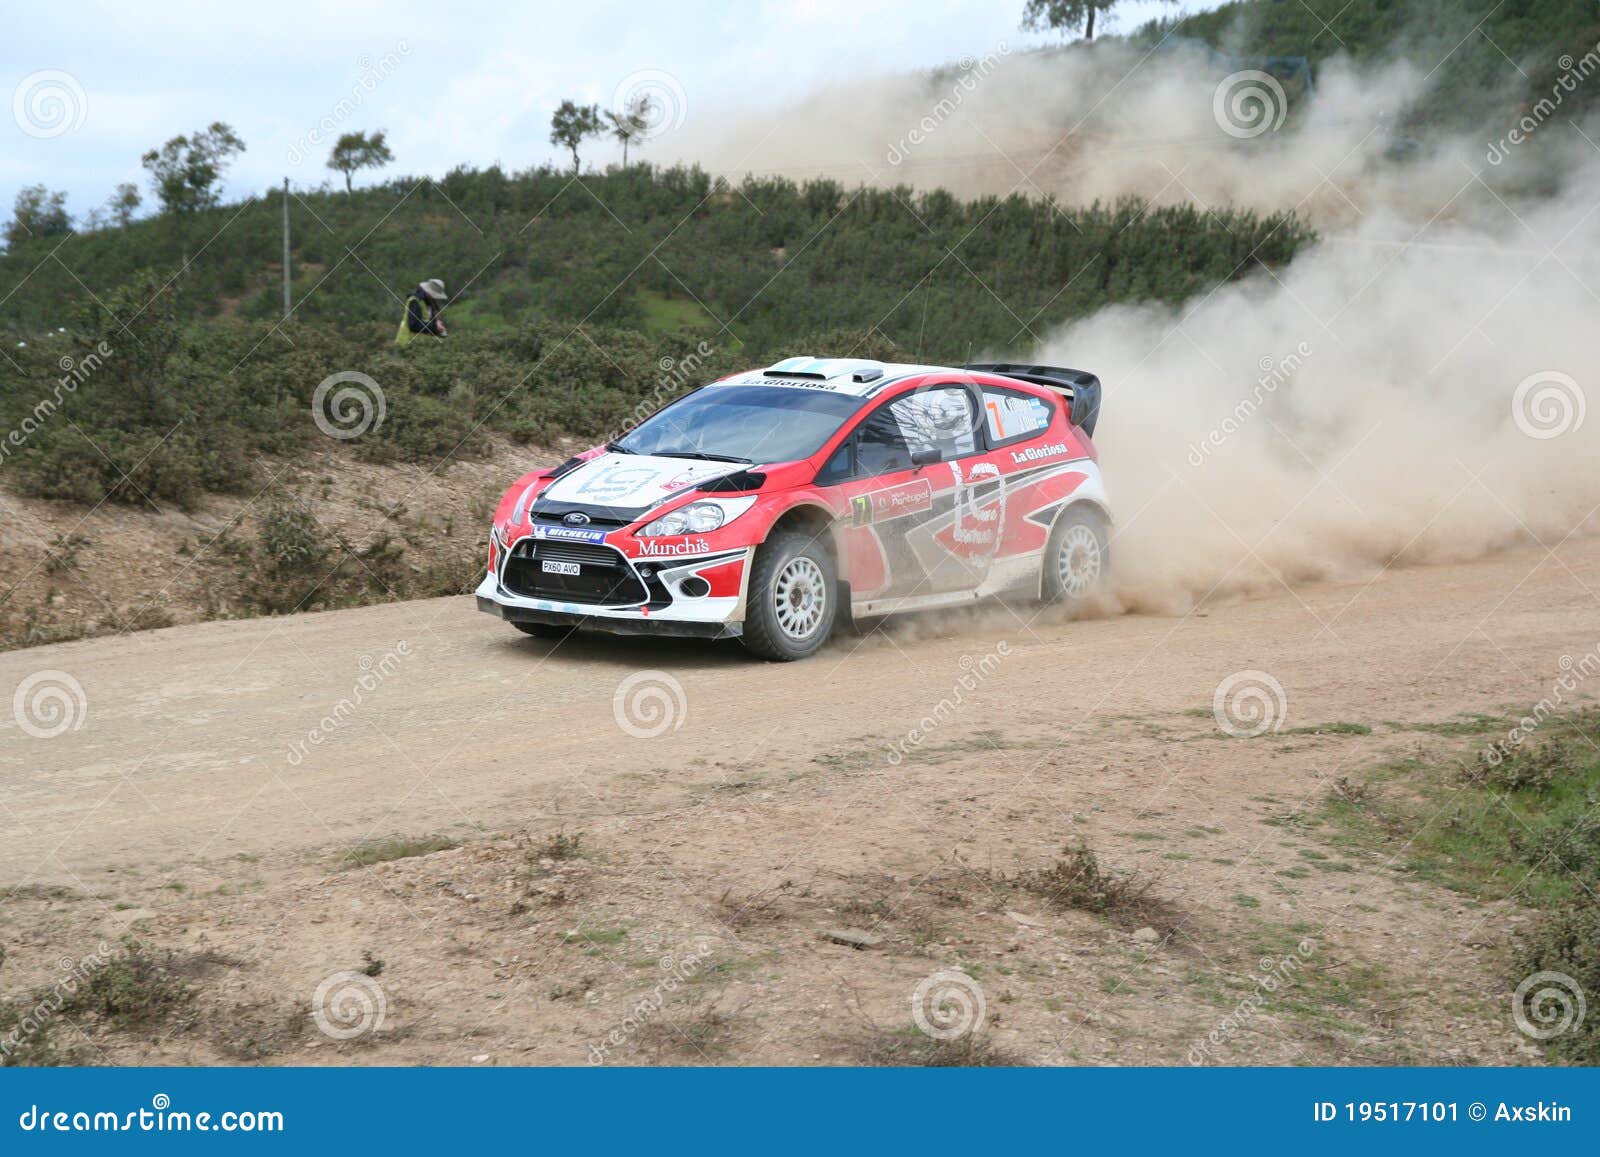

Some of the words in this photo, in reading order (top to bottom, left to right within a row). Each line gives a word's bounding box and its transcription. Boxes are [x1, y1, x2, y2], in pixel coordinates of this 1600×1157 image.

[763, 379, 838, 391] Gloriosa
[986, 400, 1006, 438] 7
[547, 527, 603, 541] MICHELIN
[637, 536, 710, 556] Munchi's
[543, 561, 561, 573] PX60
[563, 564, 579, 575] AVO
